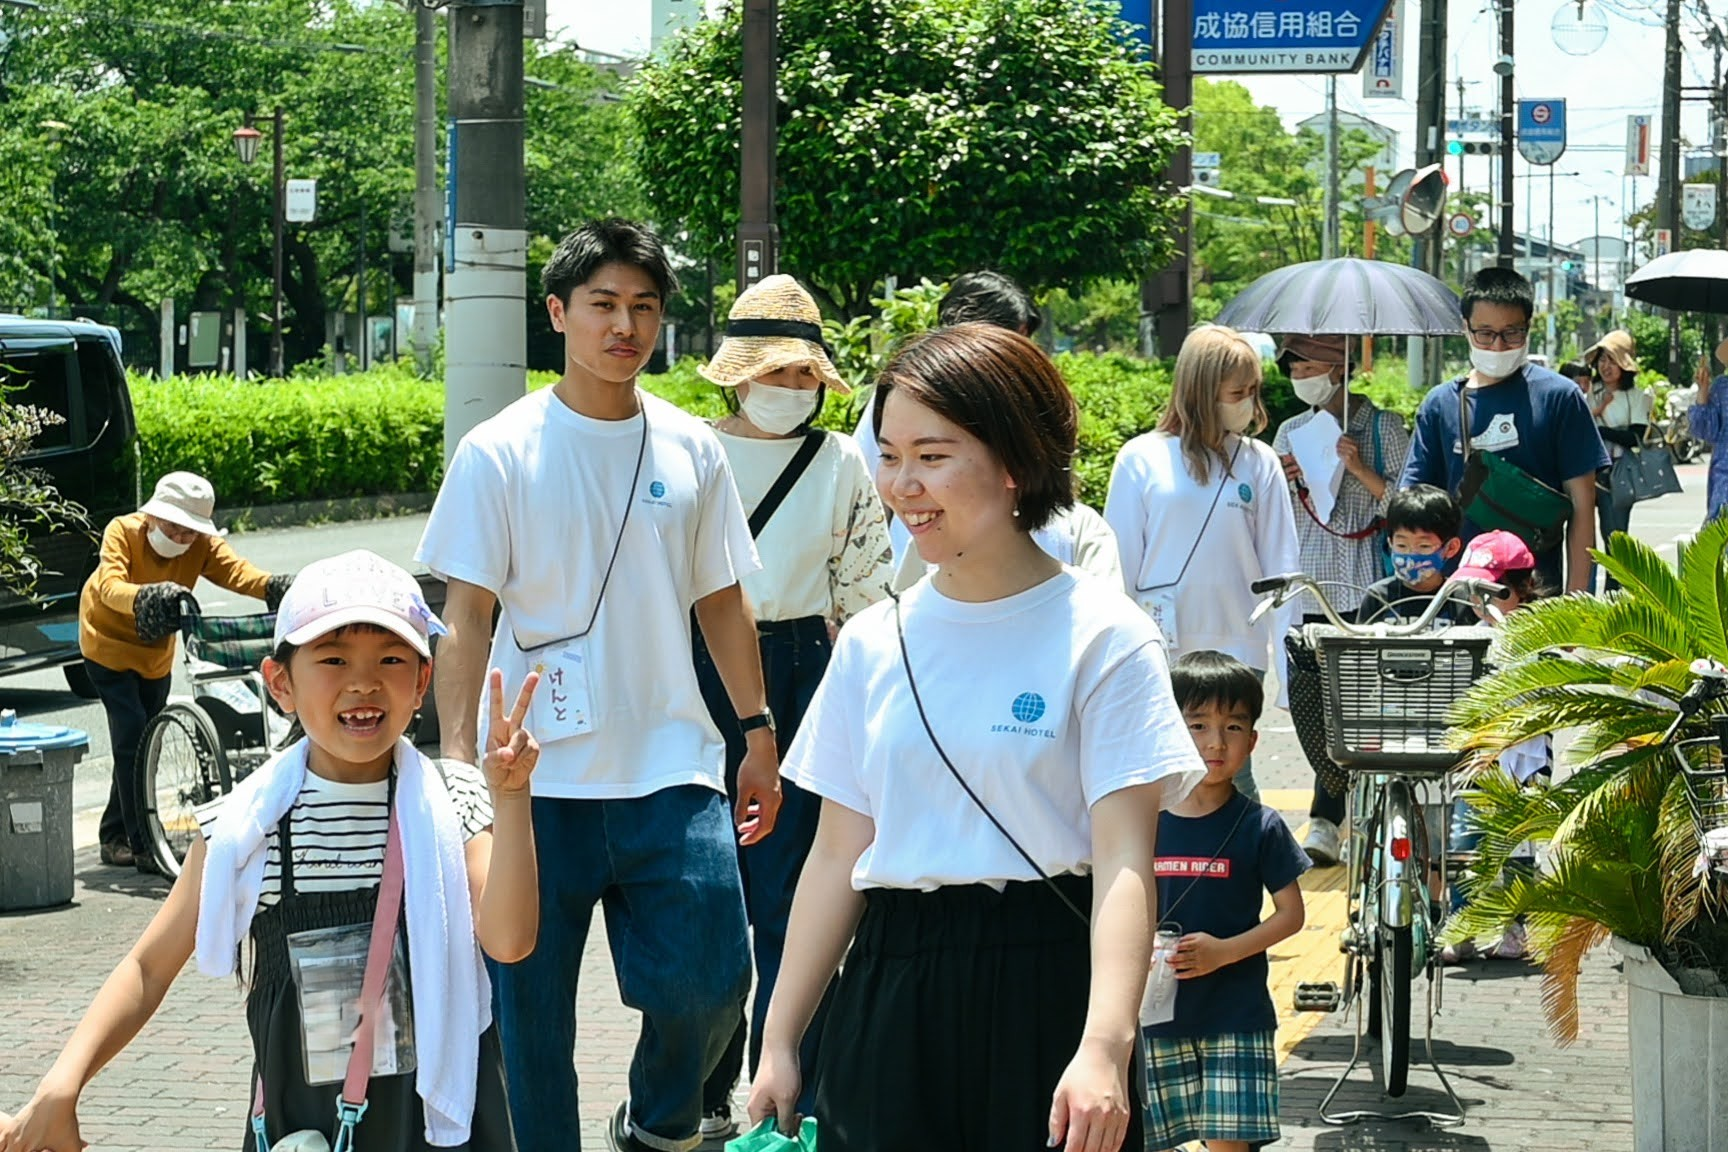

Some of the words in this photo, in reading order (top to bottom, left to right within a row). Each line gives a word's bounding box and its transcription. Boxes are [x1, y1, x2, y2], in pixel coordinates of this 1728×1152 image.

[1193, 10, 1362, 39] 成協信用組合
[1196, 54, 1298, 65] COMMUNITY
[1305, 53, 1350, 65] BANK
[548, 667, 567, 721] けんと
[991, 725, 1021, 734] SEKAI
[1024, 728, 1056, 739] HOTEL
